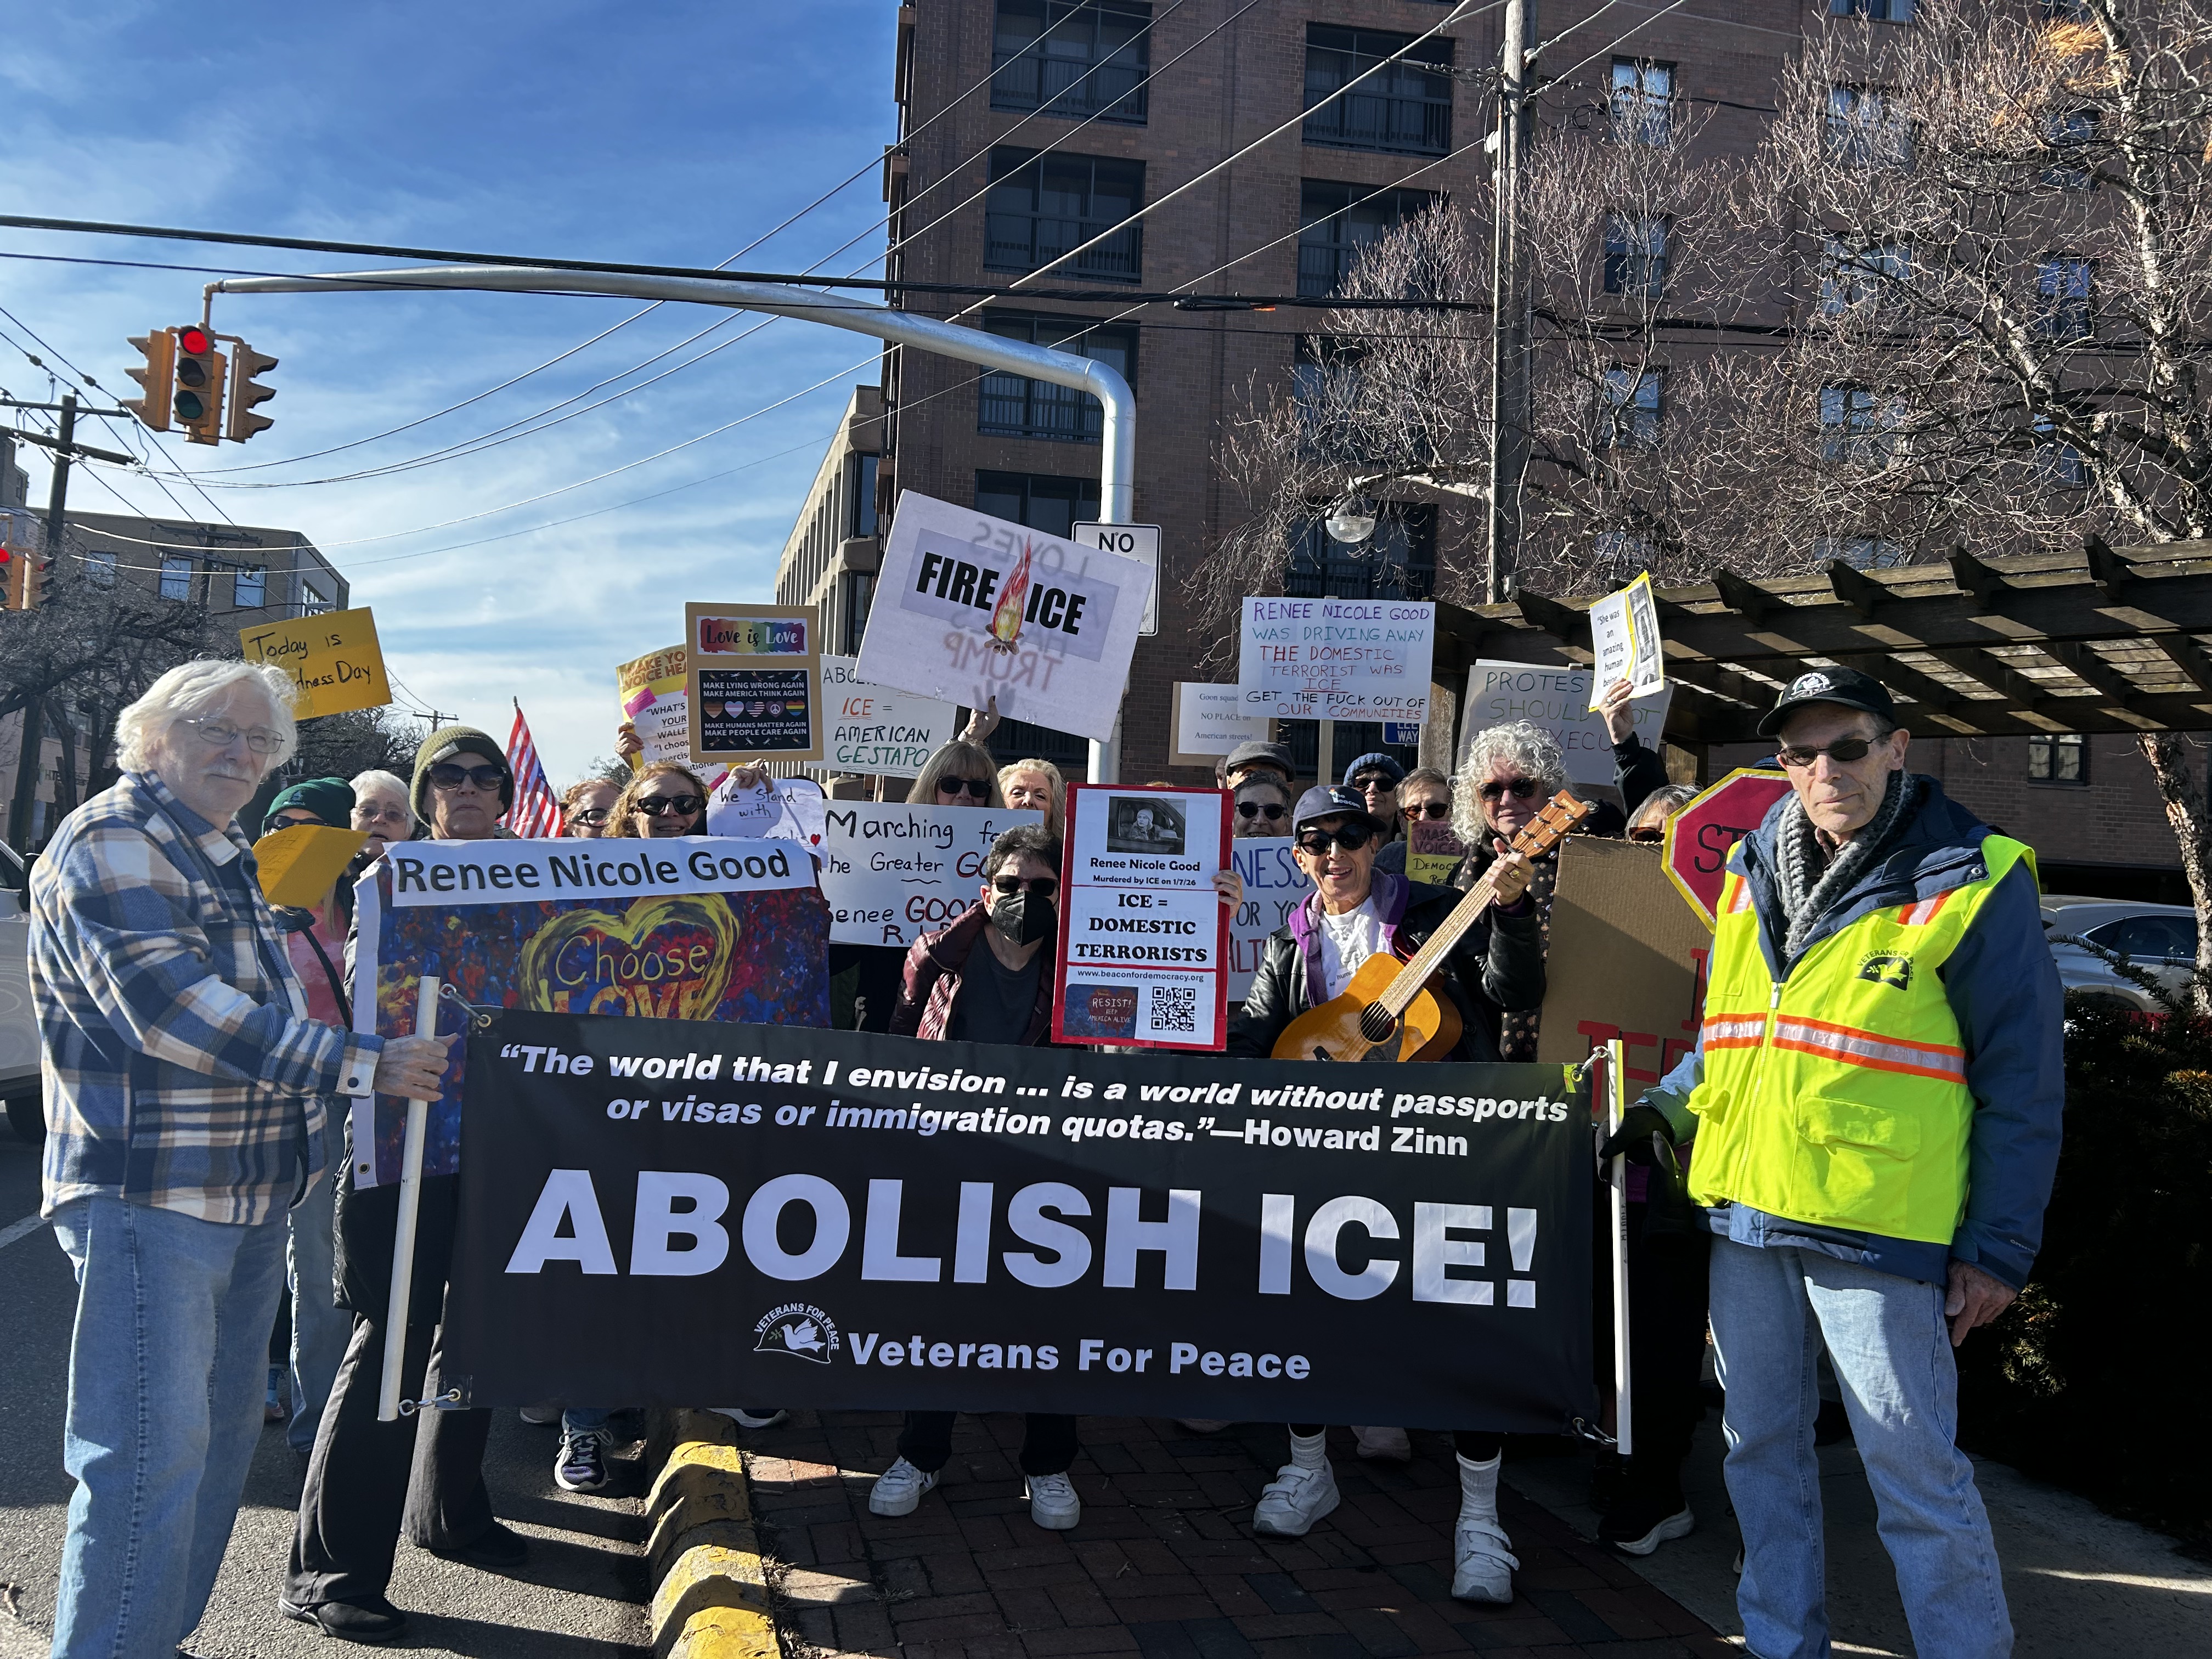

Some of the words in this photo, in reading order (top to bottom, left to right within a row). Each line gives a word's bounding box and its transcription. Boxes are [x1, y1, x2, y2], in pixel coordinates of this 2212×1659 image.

[1099, 532, 1134, 552] NO
[916, 551, 1000, 611] FIRE
[1024, 583, 1087, 635] ICE
[1254, 602, 1313, 621] RENEE
[1322, 605, 1381, 620] NICOLE
[1389, 607, 1429, 620] GOOD
[1609, 610, 1620, 620] was
[707, 625, 741, 643] Love
[747, 629, 760, 647] is
[766, 627, 798, 644] Love
[1252, 628, 1290, 640] WAS
[1304, 627, 1380, 640] DRIVING
[1386, 629, 1424, 642] AWAY
[1606, 629, 1614, 638] an
[249, 632, 308, 659] Today
[325, 634, 342, 647] is
[1260, 645, 1299, 662] THE
[1310, 646, 1395, 661] DOMESTIC
[1602, 642, 1624, 657] amazing
[664, 651, 685, 662] YO
[1270, 665, 1357, 678] TERRORIST
[1370, 665, 1403, 674] WAS
[1604, 659, 1623, 672] human
[296, 667, 335, 690] dness
[335, 661, 371, 685] Day
[625, 668, 662, 689] VOICE
[1303, 678, 1341, 690] ICE
[1485, 671, 1594, 693] PROTES
[842, 697, 874, 715] ICE
[1246, 691, 1282, 703] GET
[1292, 692, 1318, 703] THE
[1327, 693, 1365, 706] FUCK
[1373, 696, 1403, 708] OUT
[1407, 698, 1426, 708] OF
[1277, 703, 1311, 715] OUR
[1328, 706, 1421, 720] COMMUNITIES
[1633, 707, 1661, 725] OT
[662, 715, 686, 726] YOUR
[834, 726, 929, 744] AMERICAN
[1397, 730, 1419, 742] WAY
[664, 740, 689, 750] choos
[658, 752, 689, 762] exercis
[837, 744, 929, 767] GESTAPO
[720, 787, 738, 802] We
[755, 787, 797, 802] Stand
[739, 803, 771, 817] with
[826, 809, 953, 849] Marching
[1694, 823, 1748, 873] ST
[397, 859, 540, 893] Renee
[549, 854, 679, 887] Nicole
[688, 848, 790, 881] Good
[828, 855, 850, 873] he
[871, 851, 944, 872] Greater
[1090, 857, 1126, 868] Renee
[1129, 859, 1166, 870] Nicole
[1169, 861, 1200, 871] Good
[1413, 858, 1457, 870] DEMOC
[1093, 875, 1132, 883] Murdered
[1133, 877, 1144, 885] by
[826, 908, 894, 923] enee
[905, 895, 983, 923] GOO
[1118, 894, 1153, 908] ICE
[1236, 901, 1261, 926] OR
[1088, 917, 1196, 934] DOMESTIC
[1075, 943, 1207, 962] TERRORISTS
[1857, 950, 1898, 966] VETERANS
[555, 934, 708, 993] Choose
[1077, 970, 1204, 982] www.beaconfordemocracy.org
[1092, 997, 1132, 1008] RESIST!
[500, 1043, 594, 1076] “The
[609, 1053, 723, 1080] world
[732, 1056, 812, 1085] that
[822, 1060, 839, 1085] I
[848, 1066, 1006, 1094] envision
[1061, 1075, 1094, 1099] is
[1104, 1082, 1126, 1101] a
[1141, 1082, 1242, 1105] world
[1251, 1085, 1384, 1111] without
[1390, 1092, 1569, 1124] passports
[607, 1098, 649, 1120] or
[662, 1095, 762, 1124] visas
[775, 1105, 816, 1127] or
[825, 1100, 1052, 1137] immigration
[1390, 1126, 1468, 1156] Zinn
[504, 1169, 1201, 1291] ABOLISH
[1259, 1194, 1537, 1308] ICE!
[754, 1302, 804, 1333] VETERANS
[806, 1304, 826, 1319] FOR
[822, 1317, 839, 1351] PEACE
[848, 1332, 1059, 1369] Veterans
[1079, 1339, 1153, 1373] For
[1170, 1342, 1311, 1380] Peace
